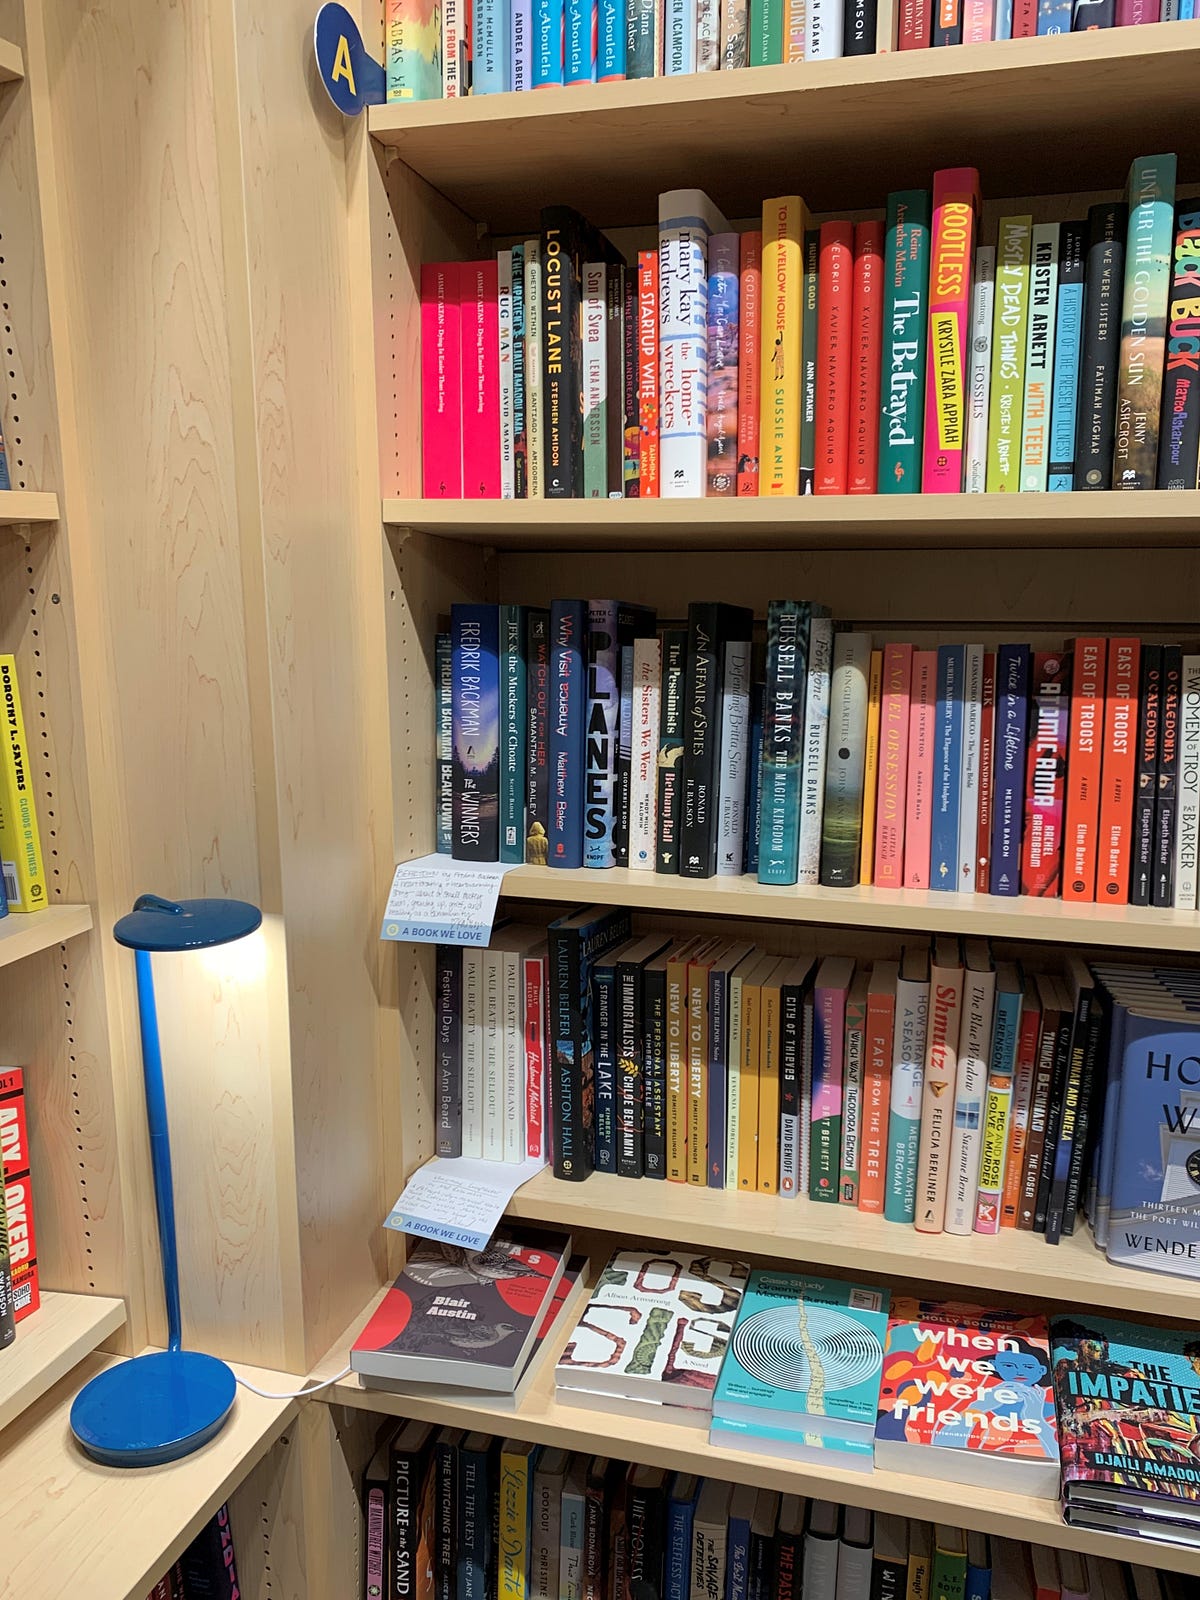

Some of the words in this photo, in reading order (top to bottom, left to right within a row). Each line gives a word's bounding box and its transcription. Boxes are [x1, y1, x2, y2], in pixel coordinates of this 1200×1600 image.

[446, 1, 456, 26] FELL
[446, 29, 456, 58] FROM
[515, 13, 523, 54] ANDREA
[539, 10, 549, 77] Aboulela
[570, 7, 582, 74] Aboulela
[604, 1, 616, 68] Aboulela
[672, 18, 682, 72] ACAMPORA
[331, 34, 358, 96] A
[447, 61, 456, 81] THE
[515, 59, 523, 91] ABREU
[778, 206, 787, 221] TO
[1136, 169, 1157, 230] UNDER
[778, 224, 787, 241] FILL
[936, 202, 973, 296] ROOTLESS
[1136, 236, 1153, 265] THE
[547, 229, 561, 313] LOCUST
[676, 231, 691, 284] mary
[778, 250, 787, 293] YELLOW
[1034, 242, 1052, 306] KRISTEN
[588, 272, 602, 293] Son
[643, 270, 652, 287] THE
[661, 239, 676, 324] andrews
[588, 297, 602, 308] of
[676, 289, 697, 325] kay
[777, 296, 785, 331] HOUSE
[893, 291, 920, 335] The
[1000, 282, 1022, 326] DEAD
[1131, 271, 1150, 347] GOLDEN
[588, 314, 602, 342] Svea
[641, 292, 655, 356] STARTUP
[1031, 314, 1048, 369] ARNETT
[1166, 297, 1200, 371] BUCK
[548, 321, 562, 374] LANE
[681, 342, 691, 360] the
[938, 320, 955, 367] KRYSTLE
[1000, 331, 1020, 379] THINGS
[642, 362, 655, 398] WIFE
[665, 344, 679, 429] wreckers
[941, 370, 956, 399] ZARA
[1127, 352, 1145, 385] SUN
[551, 382, 559, 424] STEPHEN
[681, 370, 697, 426] home-
[806, 382, 814, 422] APTAKER
[882, 339, 918, 447] Betrayed
[1027, 383, 1045, 419] WITH
[774, 389, 784, 439] SUSSIE
[943, 403, 959, 443] APPIAH
[1117, 398, 1131, 459] ASHCROFT
[1134, 412, 1147, 444] JENNY
[774, 446, 783, 479] ANIE
[1025, 425, 1043, 466] TEETH
[460, 622, 480, 671] FREDRIK
[507, 620, 517, 640] JFK
[508, 643, 517, 653] &
[777, 614, 797, 682] RUSSELL
[508, 656, 518, 673] the
[642, 662, 653, 681] the
[1082, 646, 1098, 677] EAST
[1, 665, 17, 727] DOROTHY
[460, 677, 480, 736] BACKMAN
[508, 676, 518, 720] Muckers
[641, 685, 652, 725] Sisters
[1081, 683, 1096, 699] OF
[10, 730, 18, 741] L.
[508, 722, 519, 734] of
[585, 631, 612, 839] PLANES
[774, 692, 793, 743] BANKS
[1079, 704, 1095, 753] TROOST
[508, 735, 519, 772] Choate
[641, 729, 651, 747] We
[11, 744, 26, 791] SAYERS
[640, 752, 651, 781] Were
[775, 750, 788, 769] THE
[662, 773, 676, 817] Bethany
[688, 779, 694, 790] H.
[773, 774, 786, 804] MAGIC
[19, 797, 28, 829] CLOUDS
[461, 791, 480, 845] WINNERS
[685, 791, 694, 828] BALSON
[697, 785, 706, 824] RONALD
[1004, 789, 1012, 825] MELISSA
[23, 829, 31, 840] OF
[662, 820, 674, 843] Ball
[771, 808, 785, 851] KINGDOM
[1077, 824, 1087, 845] Ellen
[1180, 814, 1197, 869] BARKER
[26, 841, 36, 877] WITNESS
[1075, 847, 1086, 875] Barker
[402, 927, 409, 936] A
[411, 928, 438, 938] BOOK
[440, 930, 456, 939] WE
[457, 931, 482, 941] LOVE
[442, 970, 453, 1012] Festival
[622, 974, 634, 983] THE
[600, 985, 608, 1027] STRANGER
[972, 987, 985, 1009] The
[441, 1016, 453, 1043] Days
[600, 1031, 608, 1042] IN
[622, 983, 634, 1058] IMMORTALISTS
[930, 985, 956, 1070] Shmutz
[969, 1012, 983, 1040] Blue
[442, 1053, 452, 1066] Jo
[600, 1044, 608, 1058] THE
[872, 1038, 885, 1067] FAR
[966, 1041, 980, 1092] Window
[441, 1070, 452, 1092] Ann
[560, 1068, 572, 1122] ASHTON
[598, 1063, 612, 1100] LAKE
[623, 1075, 634, 1106] CHLOE
[872, 1073, 881, 1105] FROM
[441, 1096, 452, 1129] Beard
[784, 1118, 793, 1141] DAVID
[870, 1111, 879, 1132] THE
[930, 1108, 942, 1149] FELICIA
[987, 1095, 998, 1129] SOLVE
[997, 1111, 1006, 1131] PEG
[563, 1127, 573, 1158] HALL
[623, 1109, 634, 1157] BENJAMIN
[907, 1126, 917, 1163] MEGAN
[993, 1133, 1002, 1156] AND
[783, 1144, 793, 1173] BENIOFF
[867, 1140, 880, 1178] TREE
[893, 1142, 905, 1195] BERGMAN
[981, 1140, 993, 1186] MURDER
[990, 1161, 1001, 1186] ROSE
[1029, 1153, 1039, 1169] THE
[904, 1168, 915, 1213] MAYHEW
[926, 1153, 939, 1203] BERLINER
[1025, 1170, 1037, 1198] LOSER
[1130, 1211, 1148, 1221] THE
[1152, 1215, 1177, 1225] PORT
[1142, 1200, 1188, 1215] THIRTEEN
[404, 1221, 412, 1229] A
[413, 1223, 440, 1235] BOOK
[441, 1229, 455, 1239] WE
[456, 1233, 480, 1245] LOVE
[1125, 1232, 1197, 1259] WENDE
[13, 1283, 30, 1299] SOHO
[432, 1296, 471, 1309] Blair
[604, 1291, 628, 1301] Alison
[629, 1295, 671, 1307] Armstrong
[426, 1306, 477, 1321] Austin
[921, 1314, 959, 1325] HOLLY
[963, 1319, 1014, 1331] BOURNE
[912, 1327, 1020, 1354] when
[936, 1354, 996, 1375] we
[1131, 1361, 1171, 1382] THE
[913, 1377, 1019, 1405] were
[1068, 1370, 1200, 1413] IMPATIE
[892, 1398, 1042, 1435] friends
[396, 1460, 410, 1526] PICTURE
[501, 1465, 527, 1522] Lizzie
[399, 1528, 408, 1536] in
[399, 1536, 409, 1548] the
[396, 1550, 410, 1595] SAND
[499, 1538, 524, 1595] Dante
